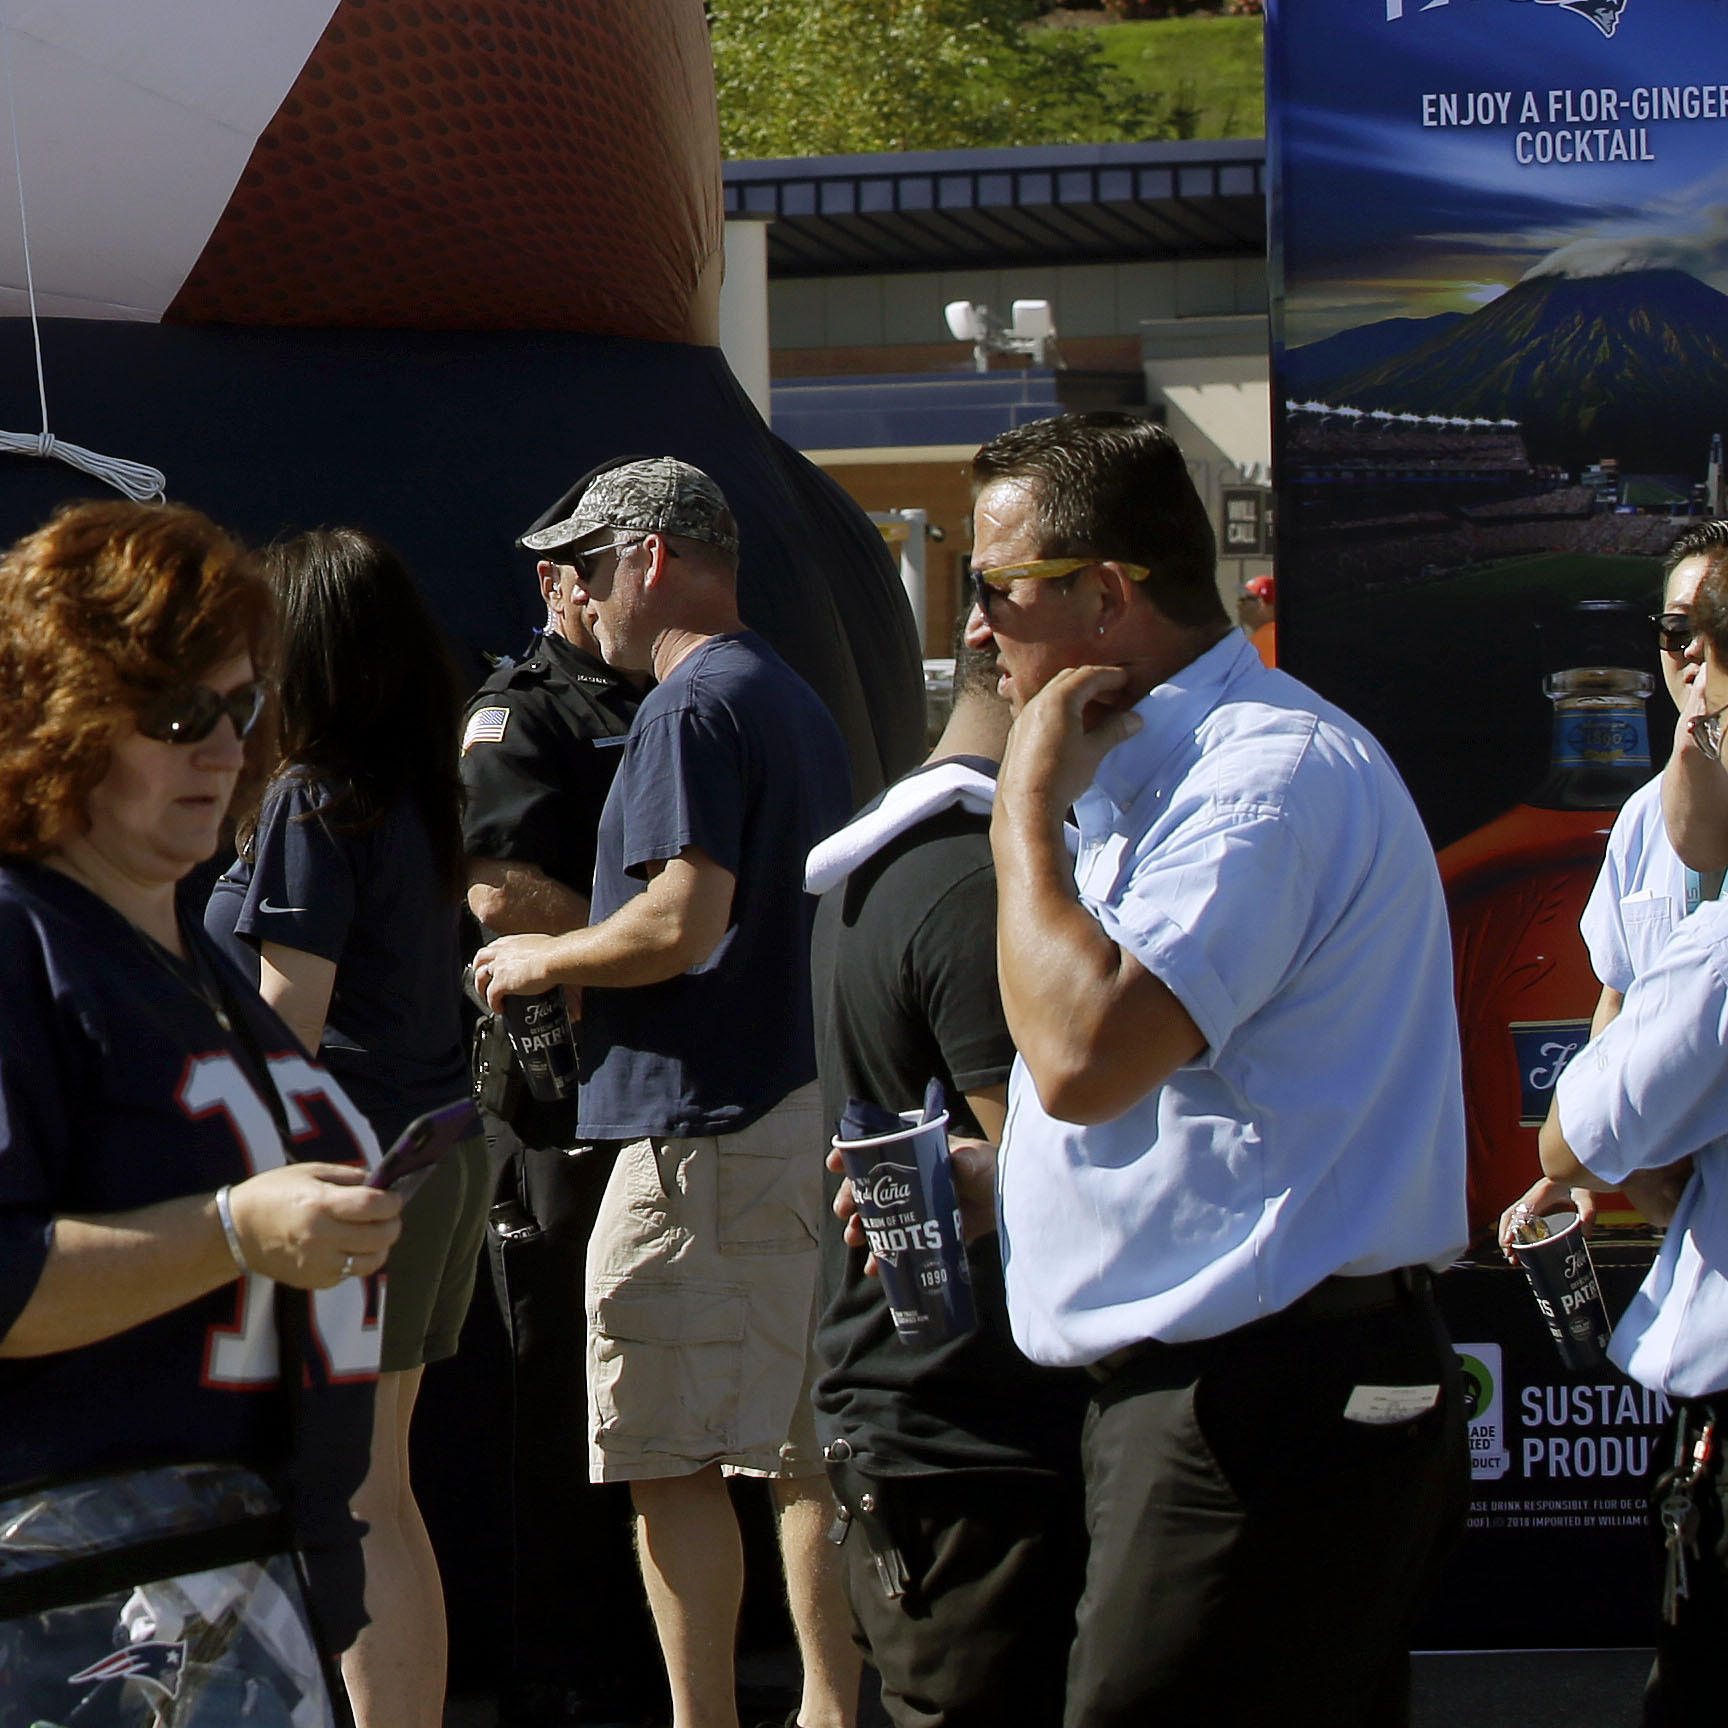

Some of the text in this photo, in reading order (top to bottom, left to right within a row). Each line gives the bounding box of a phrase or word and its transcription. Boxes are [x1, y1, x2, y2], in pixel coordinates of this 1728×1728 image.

[1422, 92, 1512, 127] ENJOY
[1520, 92, 1541, 123] A
[1516, 128, 1655, 164] COCKTAIL
[873, 1175, 911, 1209] Caña
[177, 1049, 387, 1392] 12
[899, 1210, 916, 1225] THE
[920, 1268, 948, 1288] 1890
[1469, 1425, 1496, 1438] ADE
[1523, 1436, 1660, 1477] PRODU
[1490, 1500, 1521, 1512] DRINK
[1594, 1499, 1618, 1510] FLOR
[1620, 1498, 1632, 1509] DE
[1635, 1498, 1648, 1509] CA
[1532, 1516, 1582, 1527] IMPORTED
[1584, 1515, 1595, 1526] BY
[1598, 1514, 1641, 1526] WILLIAM
